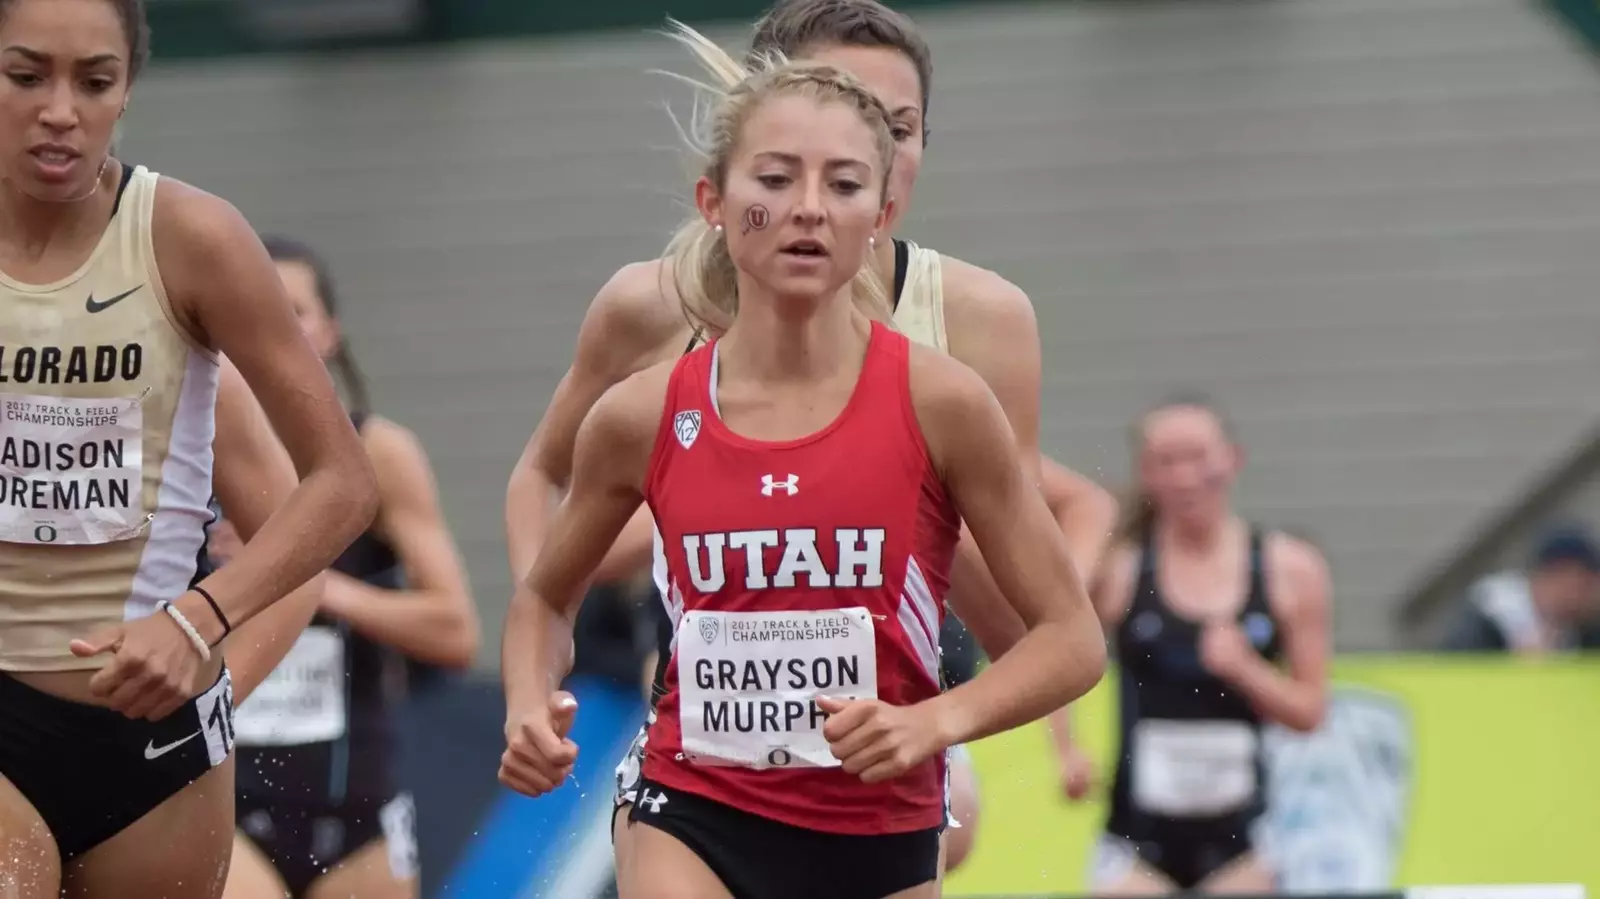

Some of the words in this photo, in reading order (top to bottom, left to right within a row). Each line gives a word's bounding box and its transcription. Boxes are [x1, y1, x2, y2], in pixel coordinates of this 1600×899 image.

[6, 401, 31, 411] 2017
[36, 404, 70, 415] TRACK
[75, 407, 81, 416] &
[86, 406, 119, 416] FIELD
[7, 410, 118, 427] CHAMPIONSHIPS
[681, 427, 695, 442] 12
[1, 436, 124, 471] ADISON
[682, 528, 885, 593] UTAH
[732, 621, 757, 630] 2017
[764, 619, 798, 629] TRACK
[804, 620, 810, 628] &
[816, 617, 850, 627] FIELD
[732, 628, 850, 642] CHAMPIONSHIPS
[695, 655, 859, 691] GRAYSON
[703, 696, 855, 732] MURPH
